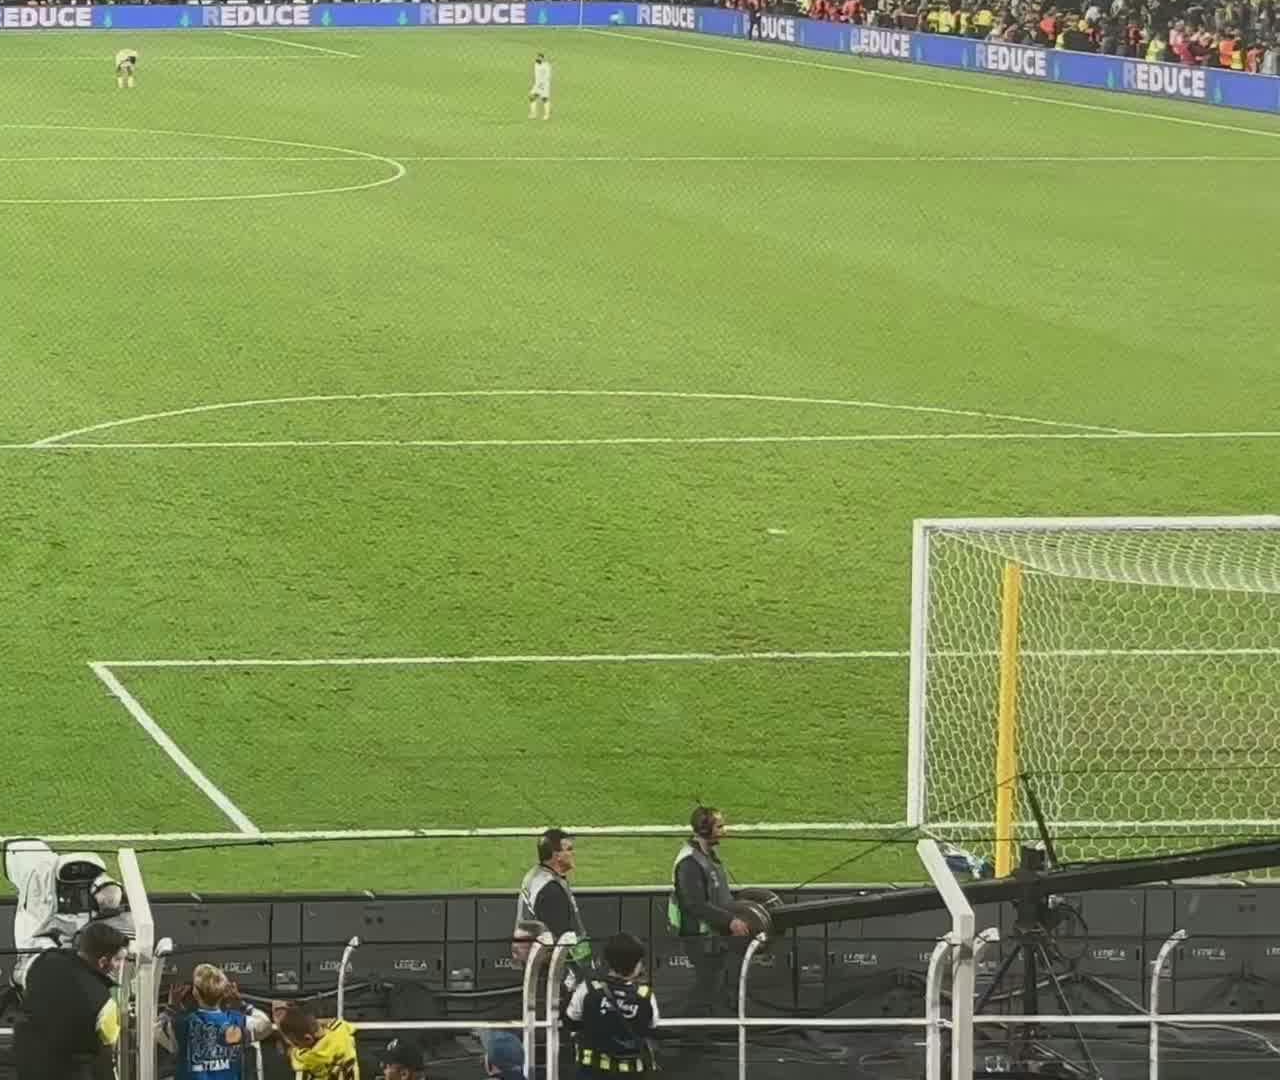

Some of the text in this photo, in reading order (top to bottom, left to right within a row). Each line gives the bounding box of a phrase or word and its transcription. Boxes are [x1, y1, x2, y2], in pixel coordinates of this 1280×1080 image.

[203, 5, 310, 26] REDUCE
[420, 3, 526, 24] REDUCE
[638, 5, 695, 30] REDUCE
[850, 27, 911, 57] REDUCE
[976, 40, 1047, 76] REDUCE
[1123, 60, 1206, 98] REDUCE
